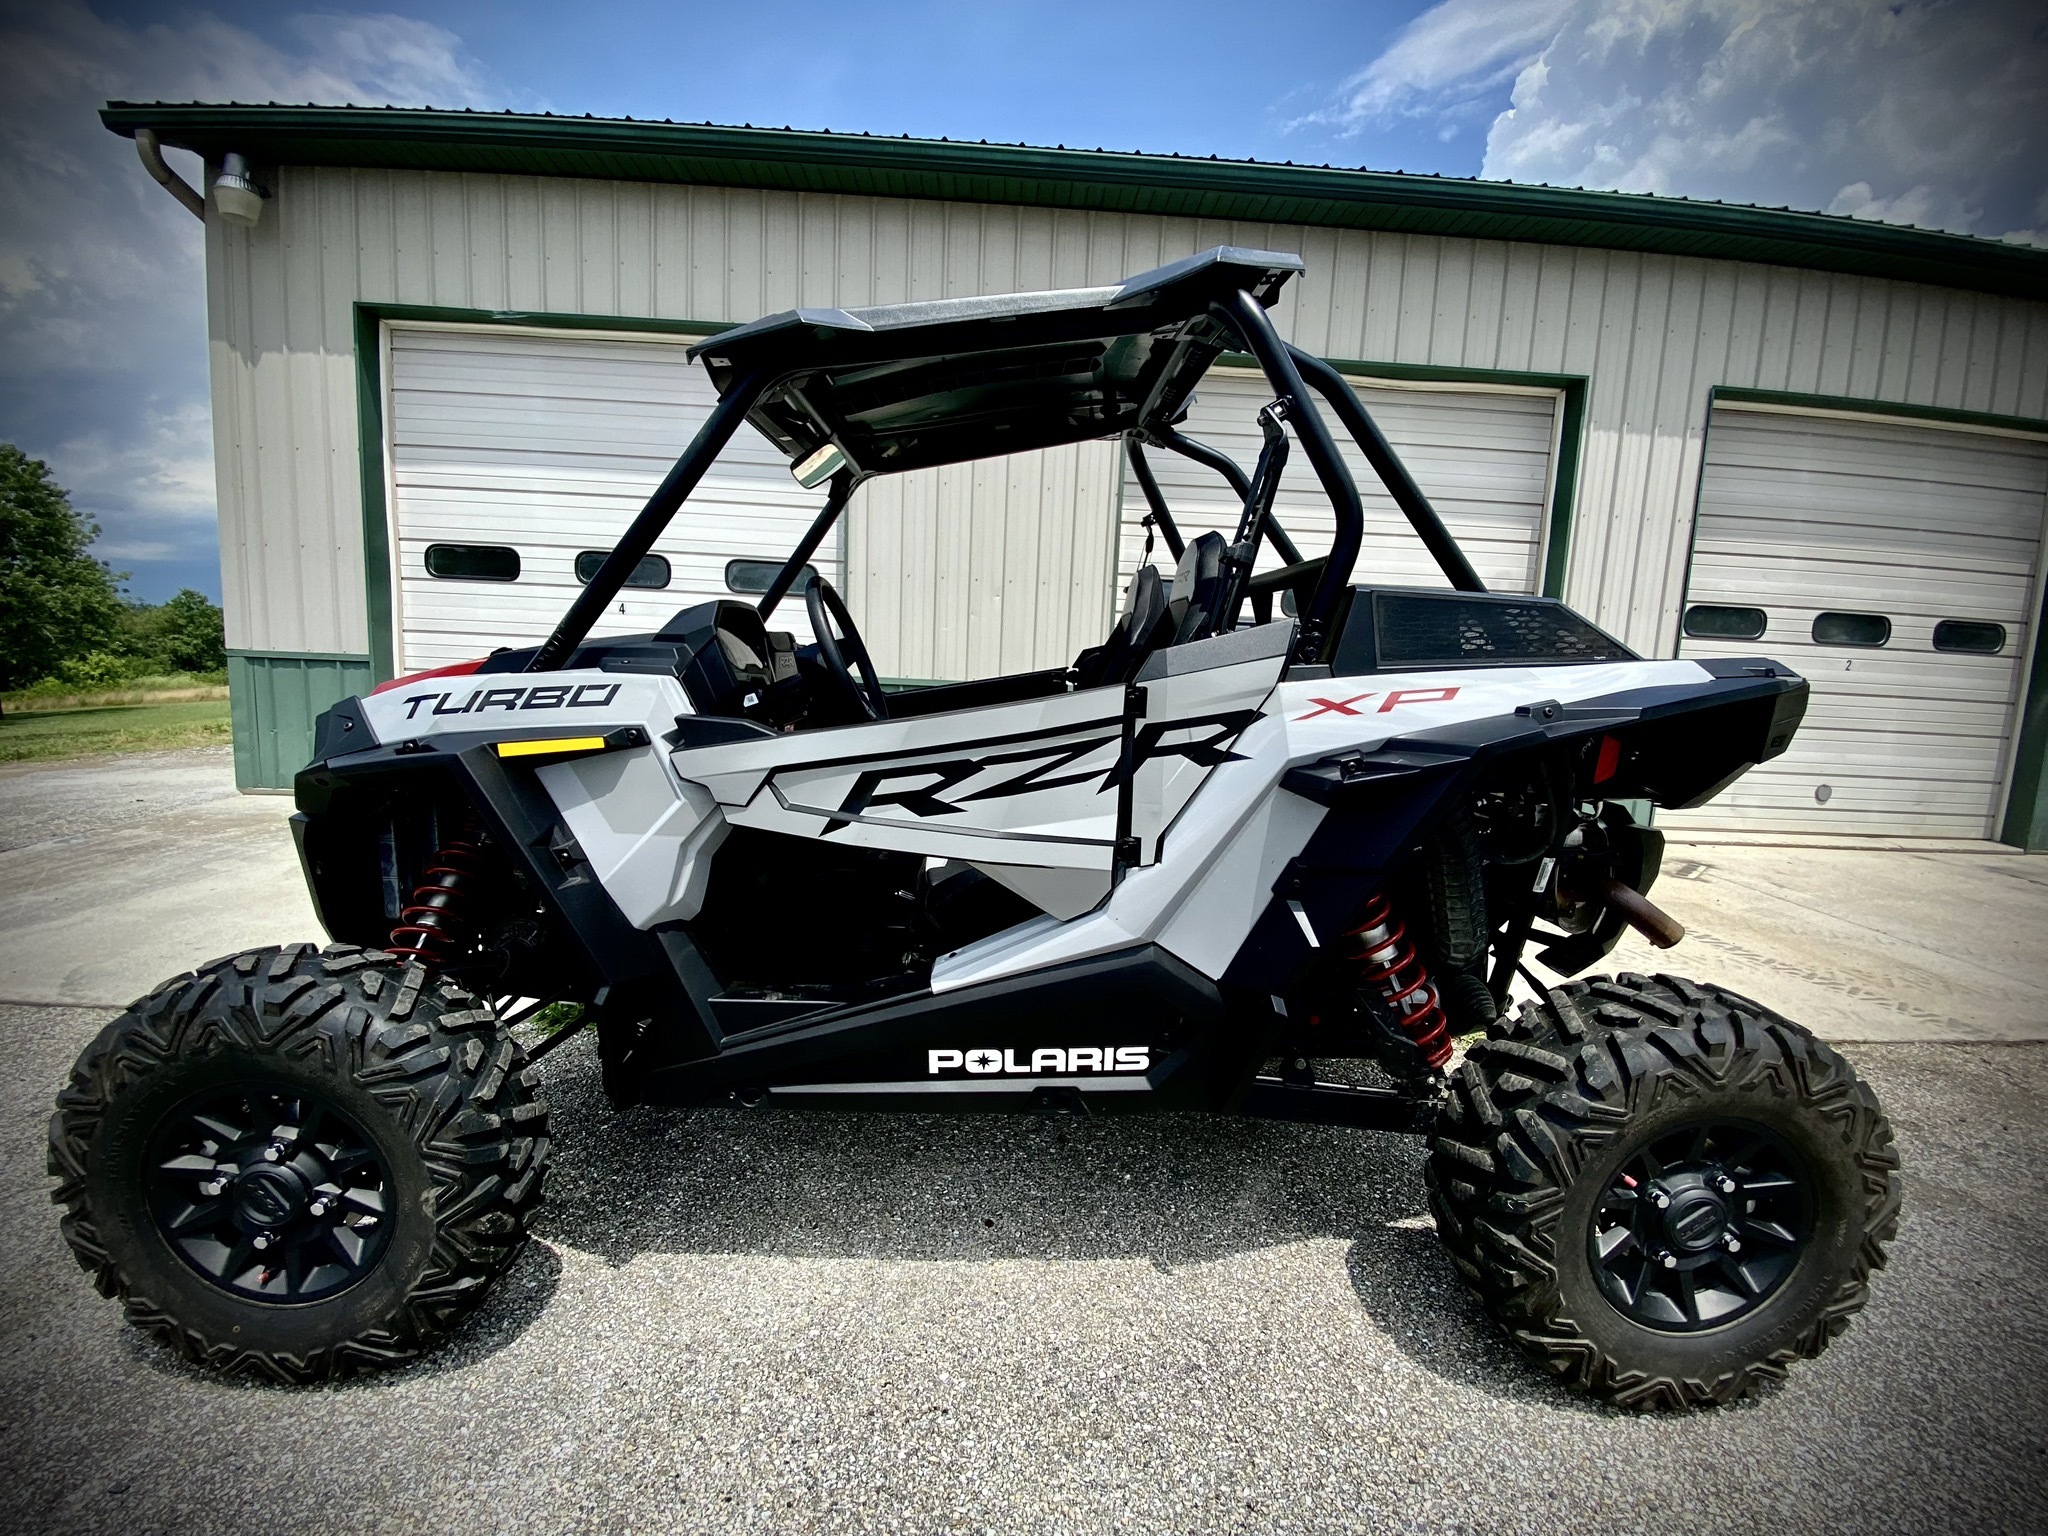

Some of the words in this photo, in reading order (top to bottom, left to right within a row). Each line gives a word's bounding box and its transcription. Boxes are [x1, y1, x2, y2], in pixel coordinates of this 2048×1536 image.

[619, 602, 626, 615] 4
[1845, 659, 1852, 671] 2
[402, 683, 623, 720] TURBO
[1288, 686, 1461, 722] XP
[818, 708, 1268, 837] RZR
[928, 1046, 1150, 1074] POLARIS
